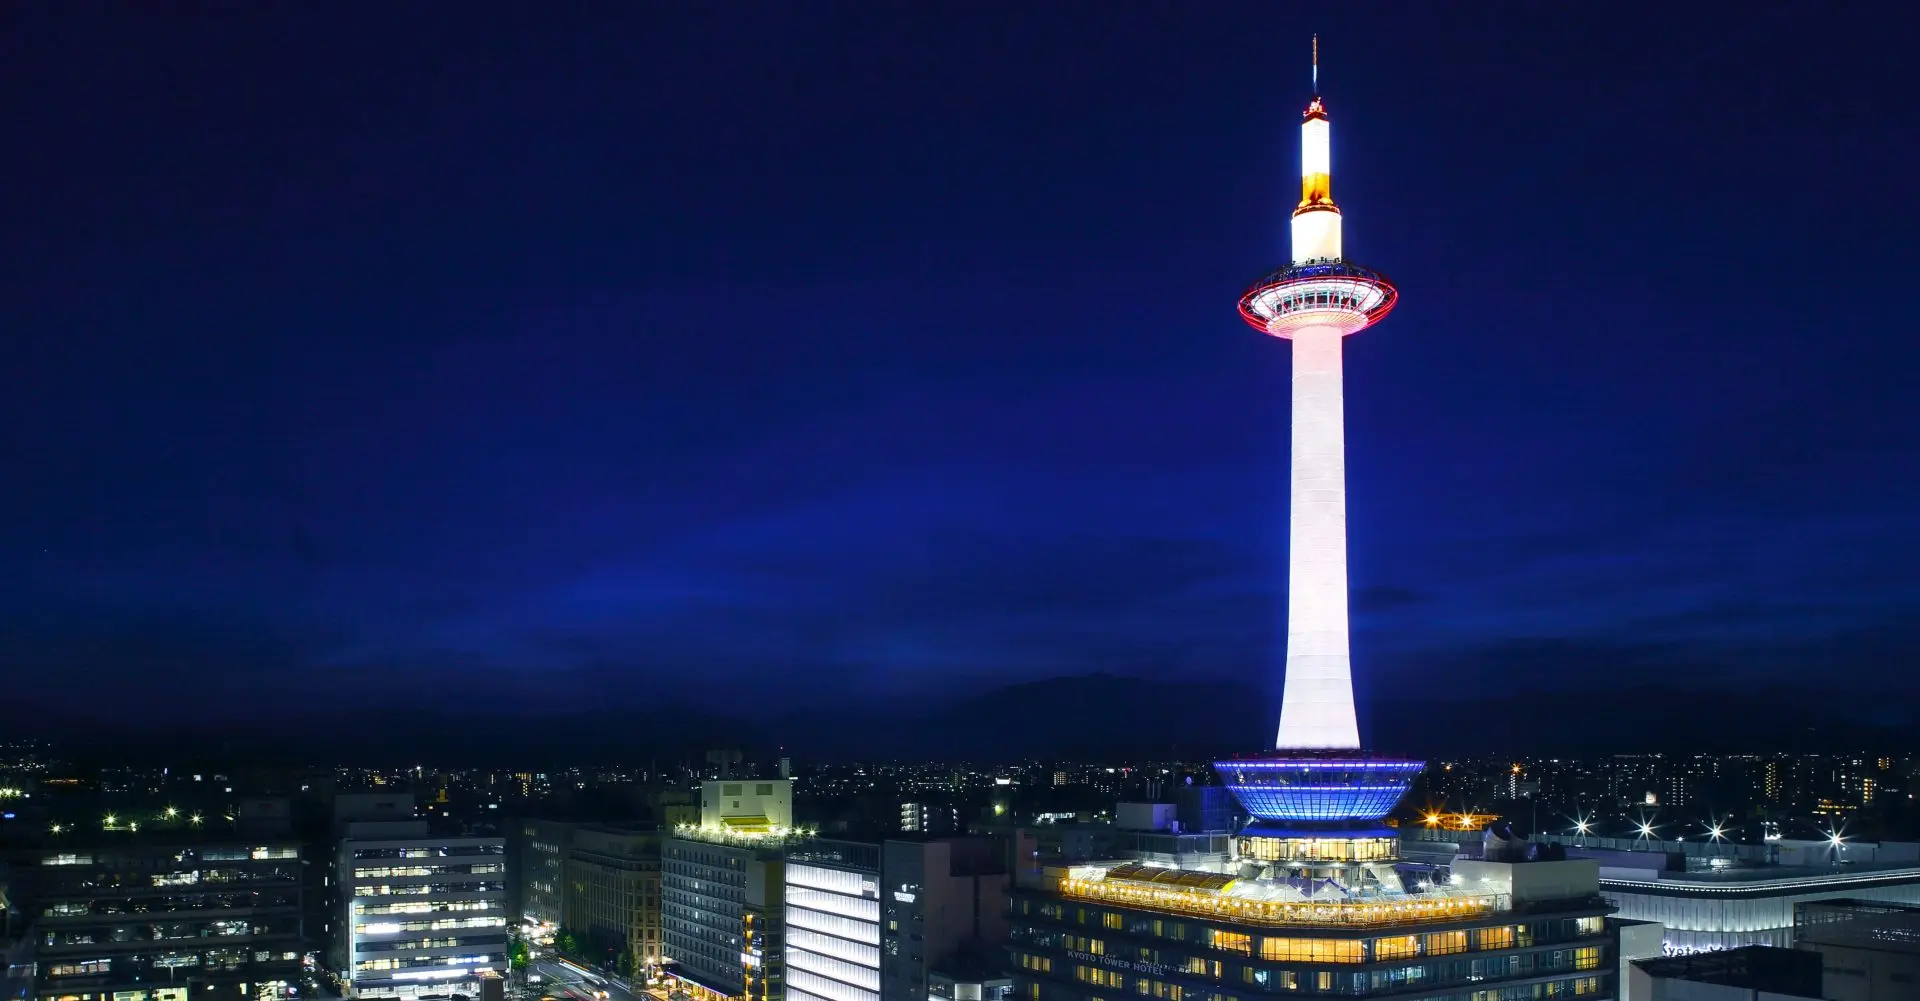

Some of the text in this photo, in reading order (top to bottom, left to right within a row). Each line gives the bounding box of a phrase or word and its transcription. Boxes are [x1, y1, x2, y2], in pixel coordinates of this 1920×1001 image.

[1067, 951, 1164, 976] KYOTO TOWER HOTEL
